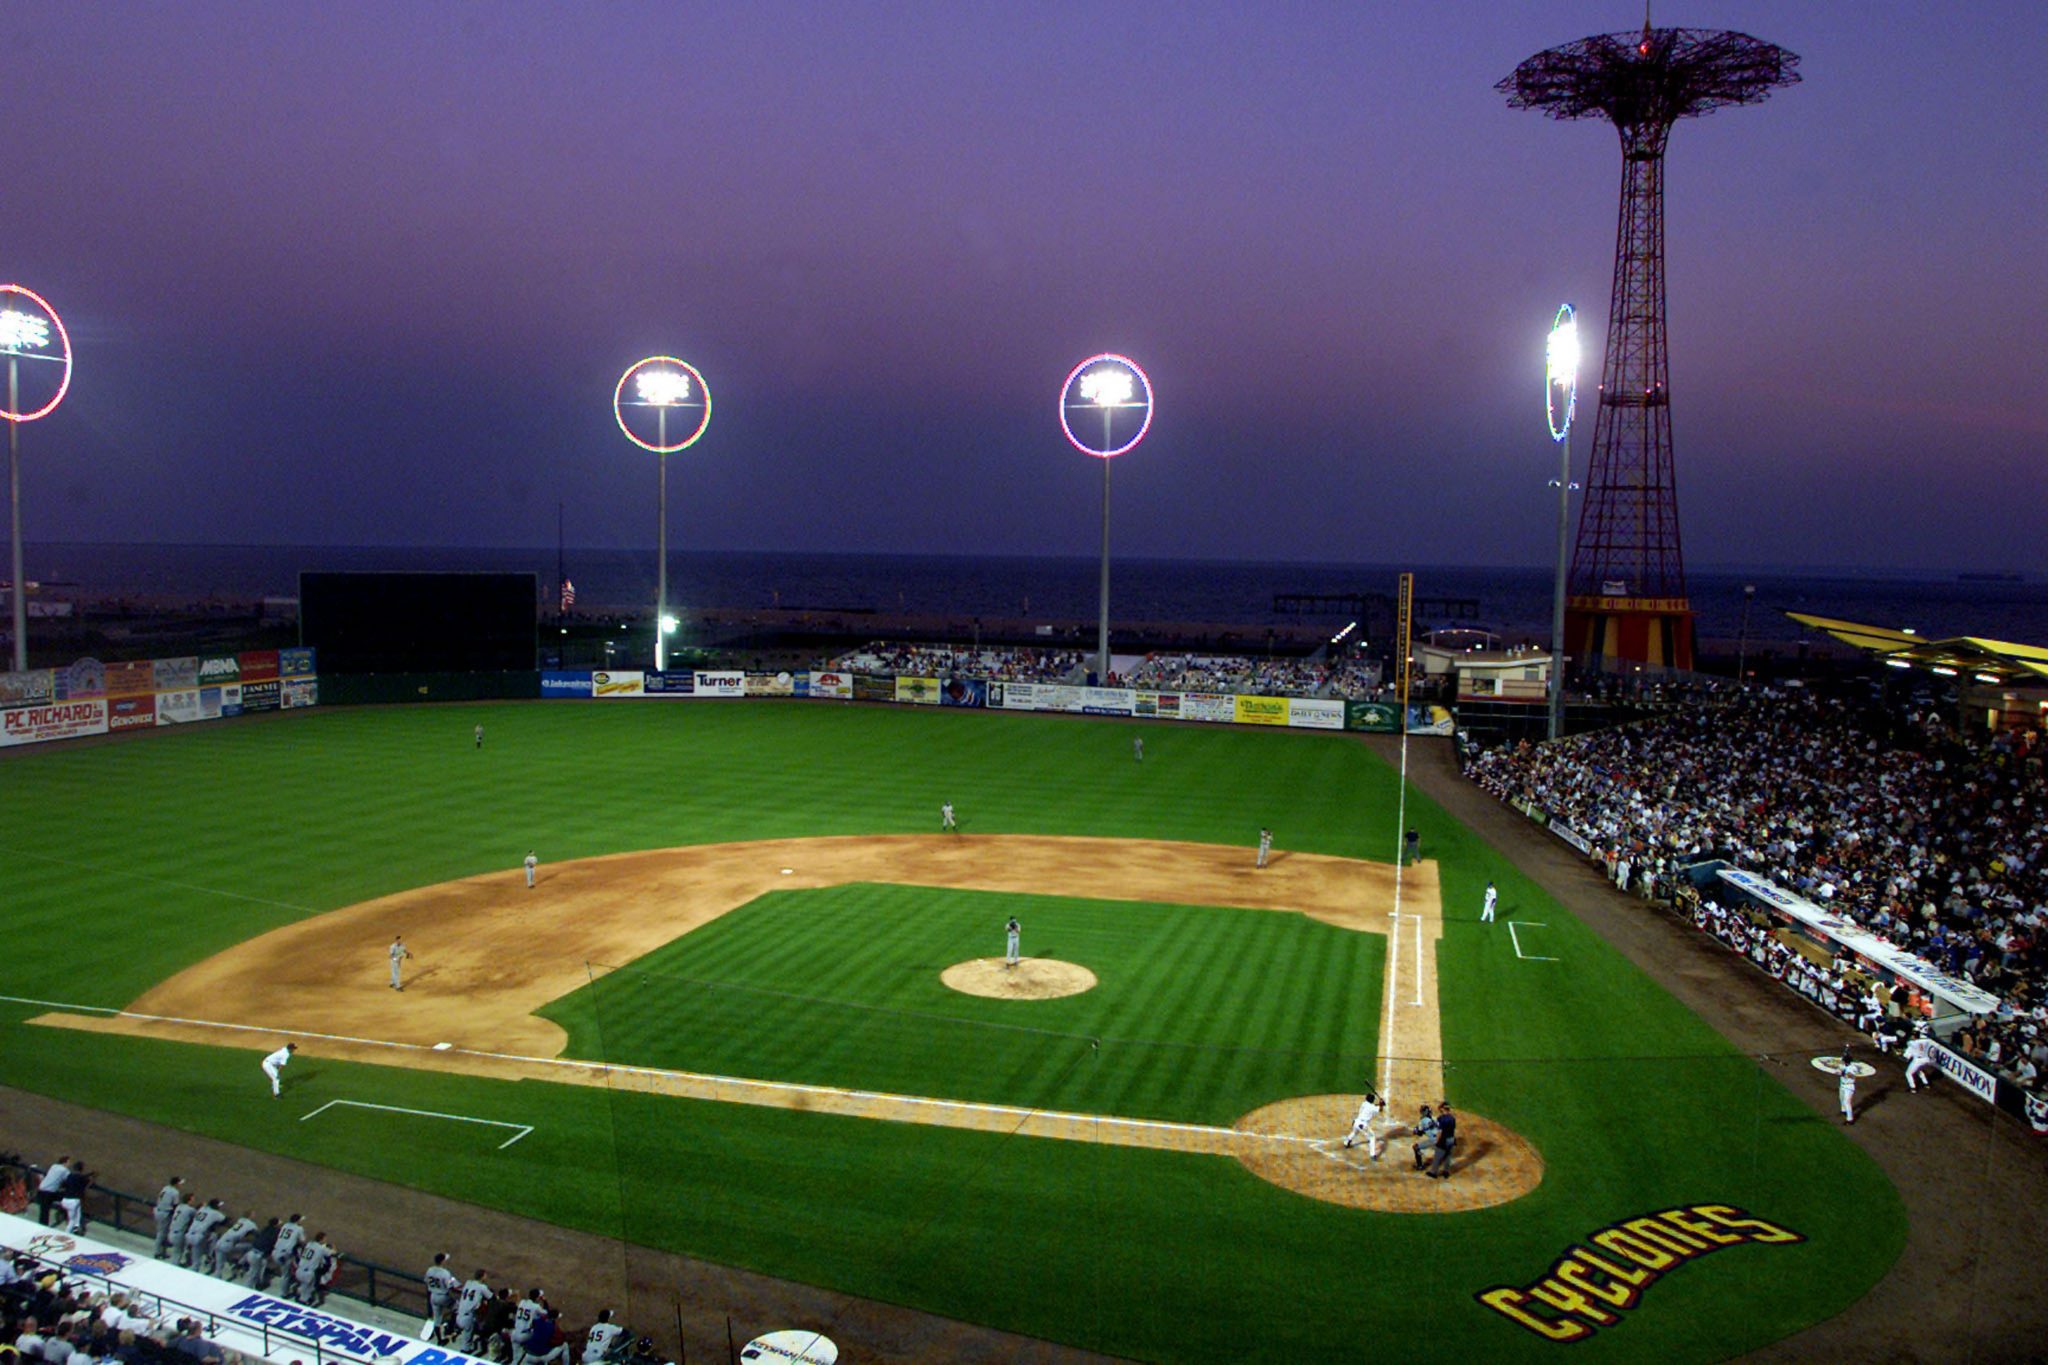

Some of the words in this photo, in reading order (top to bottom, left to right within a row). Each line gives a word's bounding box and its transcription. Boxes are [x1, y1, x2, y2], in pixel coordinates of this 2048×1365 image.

[200, 658, 239, 675] MBNA
[696, 673, 742, 687] Turner
[28, 703, 92, 726] RICHARD
[1927, 1044, 1993, 1098] CABLEVISION
[280, 1228, 293, 1239] 15
[1476, 1203, 1804, 1341] CYCLONES
[518, 1307, 531, 1320] 35
[226, 1294, 409, 1358] KEYSPAN
